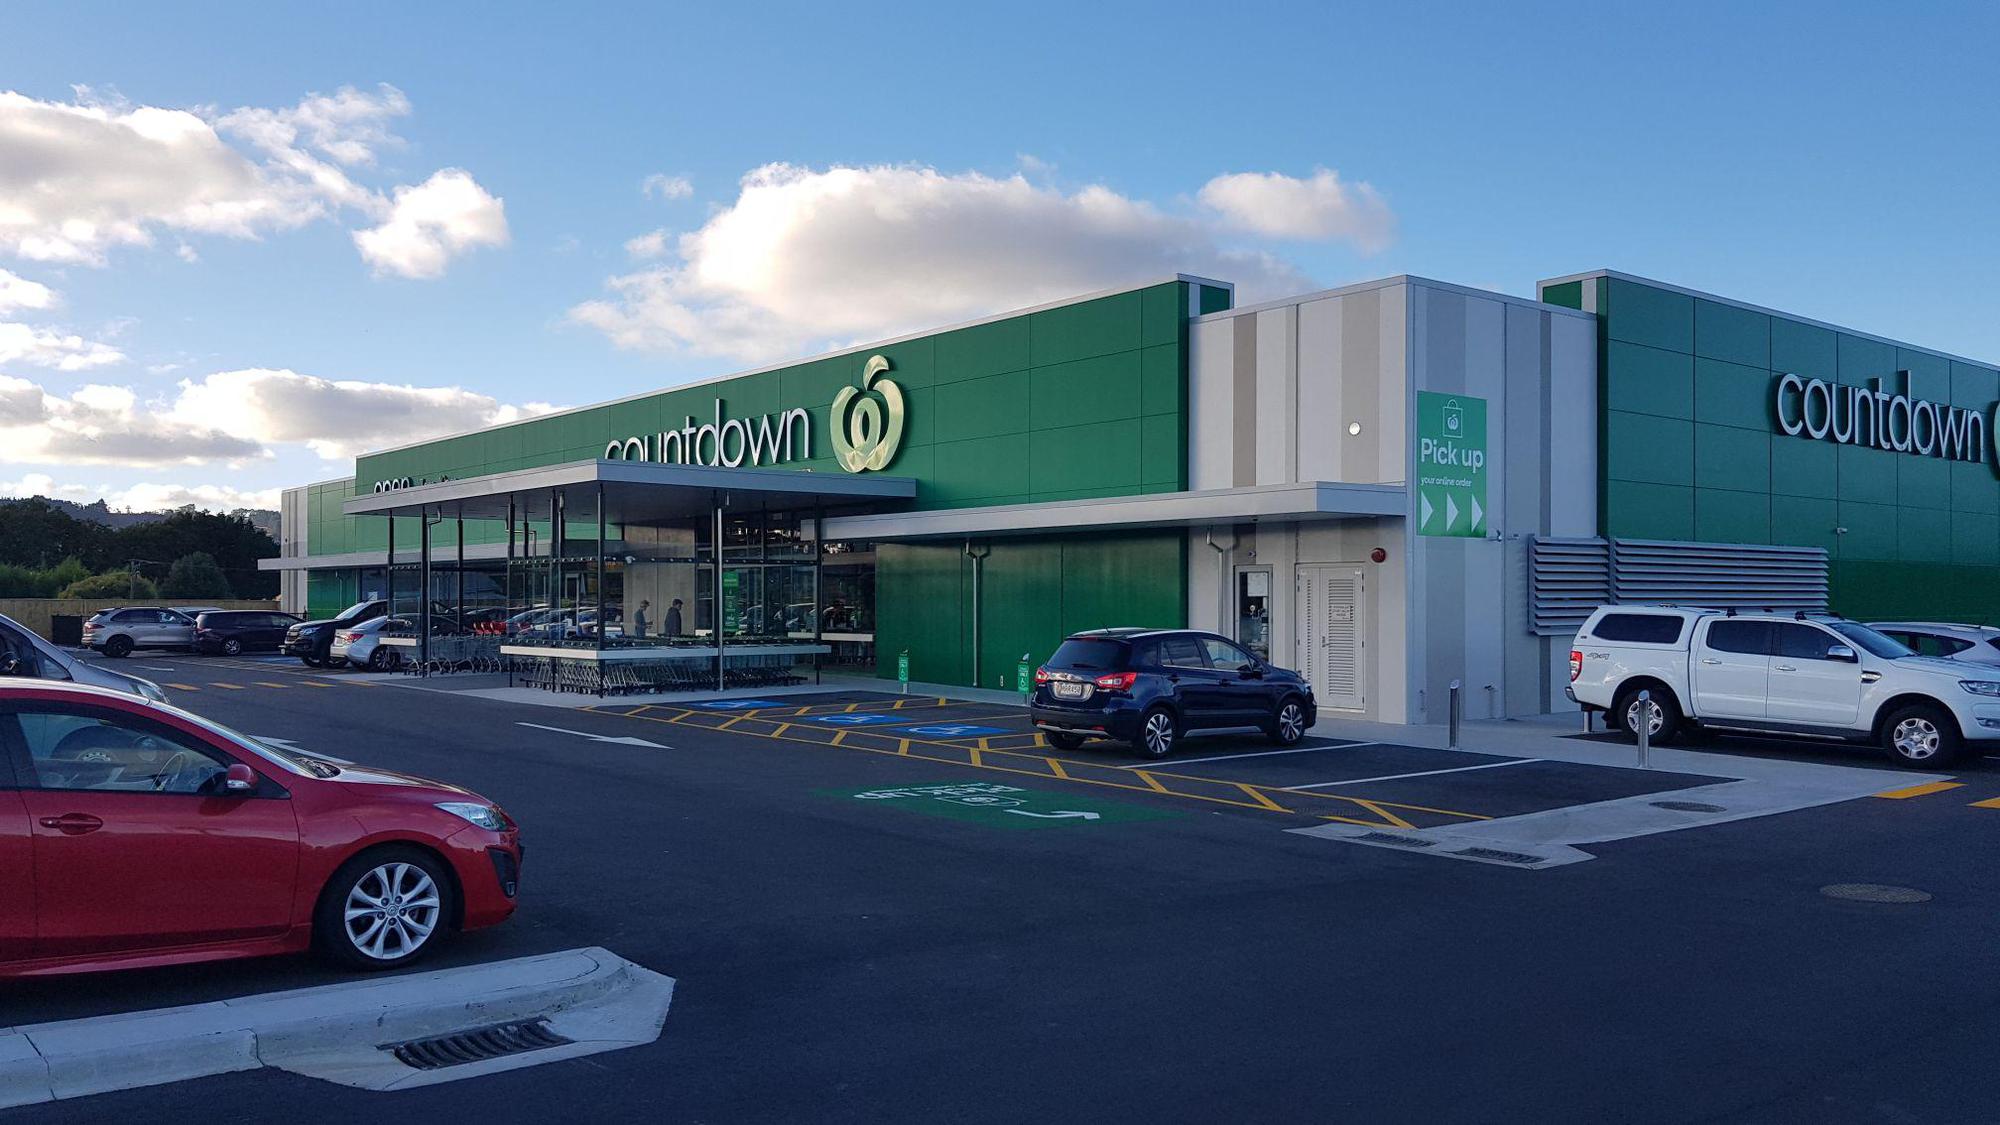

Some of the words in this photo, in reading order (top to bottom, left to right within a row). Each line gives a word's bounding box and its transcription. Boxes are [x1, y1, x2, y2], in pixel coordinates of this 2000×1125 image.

[1777, 370, 1984, 463] countdown
[1421, 438, 1457, 465] Pick
[1462, 449, 1484, 473] up
[1421, 477, 1436, 485] your
[1436, 477, 1456, 487] online
[1455, 479, 1472, 487] order
